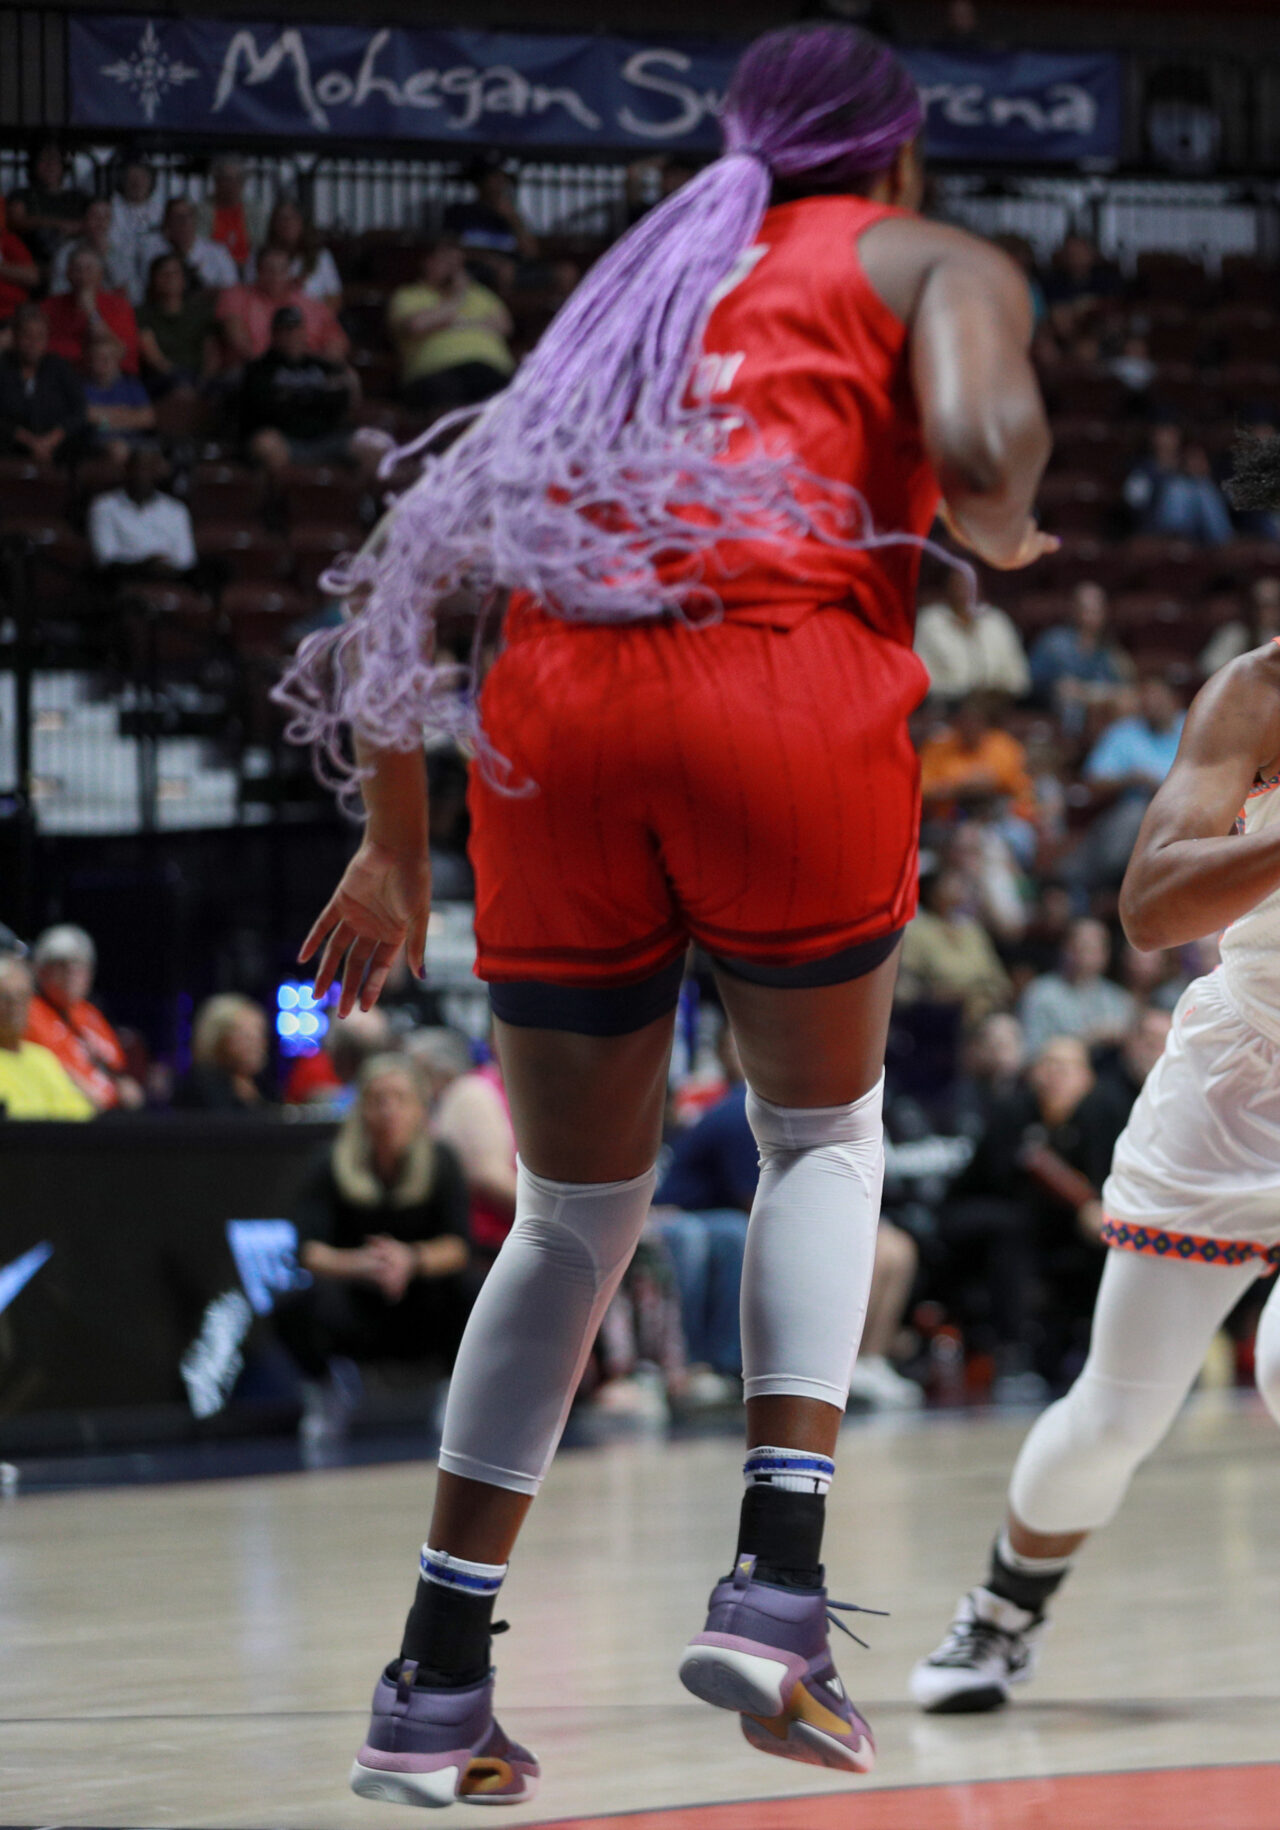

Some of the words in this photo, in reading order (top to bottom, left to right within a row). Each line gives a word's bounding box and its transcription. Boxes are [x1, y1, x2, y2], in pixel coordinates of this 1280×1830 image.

[212, 28, 601, 131] Mohegan
[617, 48, 728, 139] Su
[915, 83, 1097, 135] rena
